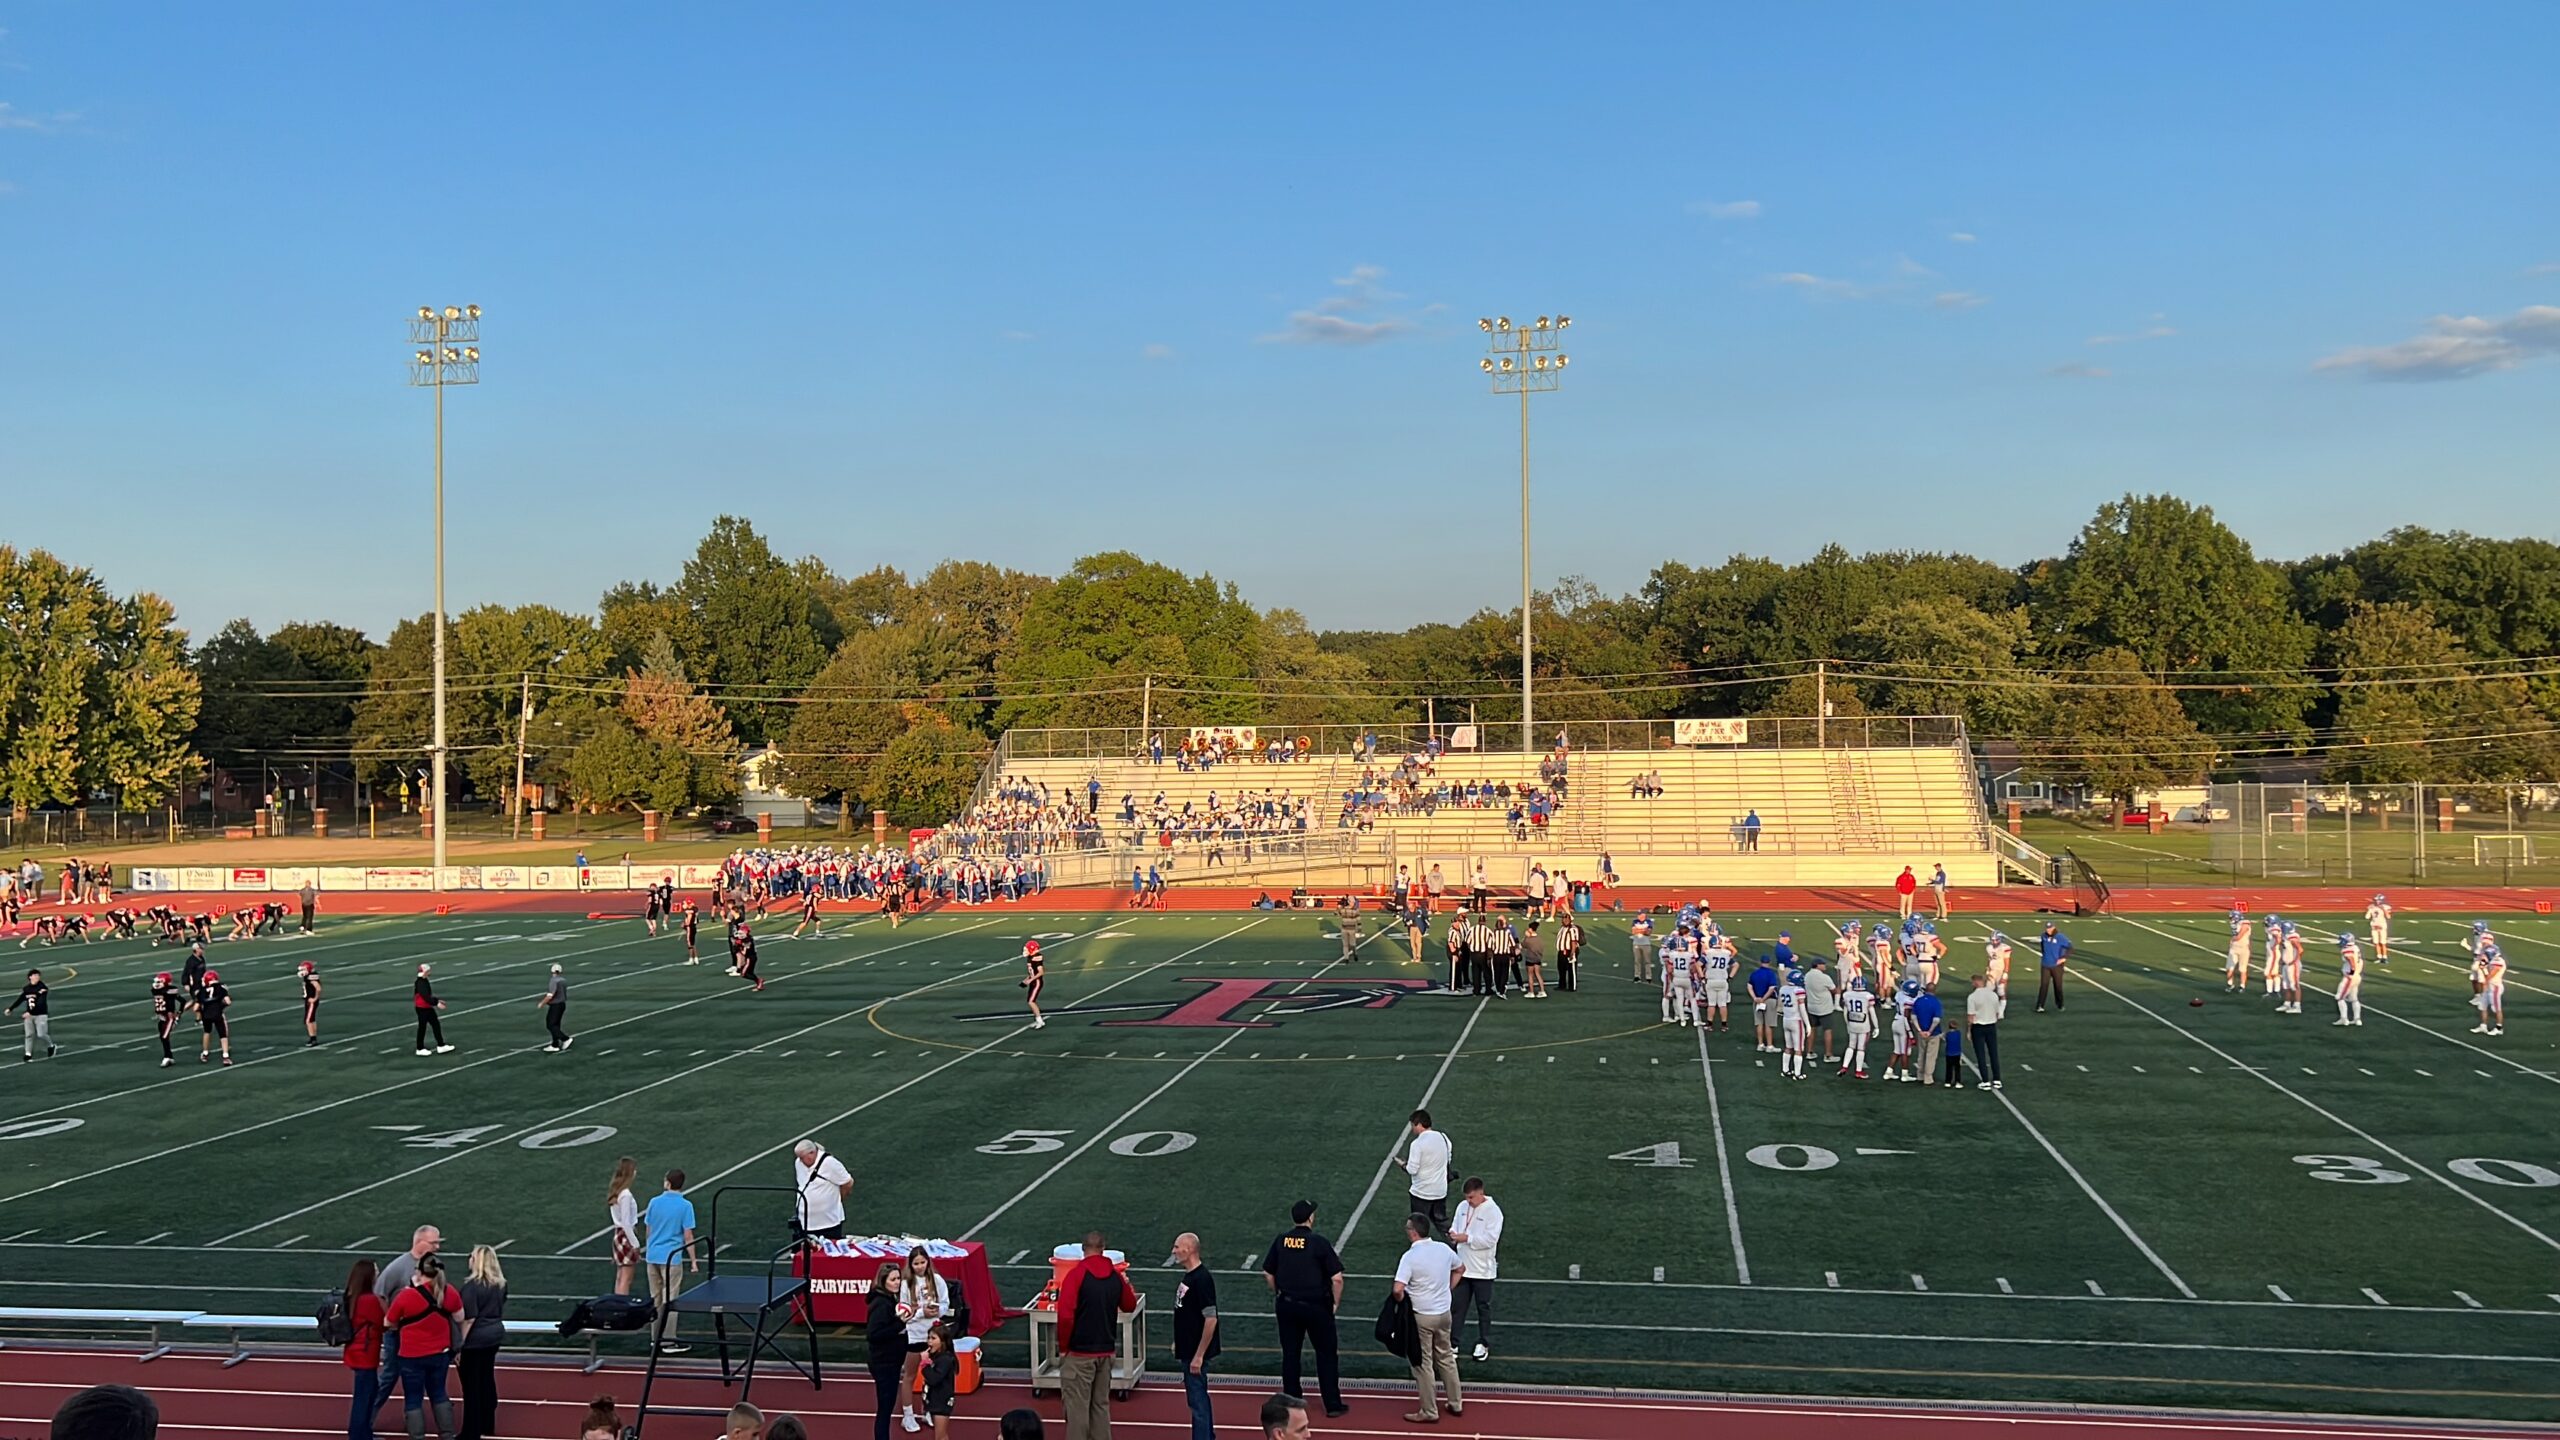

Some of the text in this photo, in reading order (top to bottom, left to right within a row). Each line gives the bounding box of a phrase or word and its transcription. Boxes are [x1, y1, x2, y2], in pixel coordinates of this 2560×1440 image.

[1674, 957, 1687, 971] 12
[1711, 956, 1727, 970] 78
[205, 986, 215, 999] 7
[1848, 999, 1863, 1013] 18
[1283, 1237, 1306, 1249] POLICE
[810, 1279, 872, 1294] FAIRVIEW
